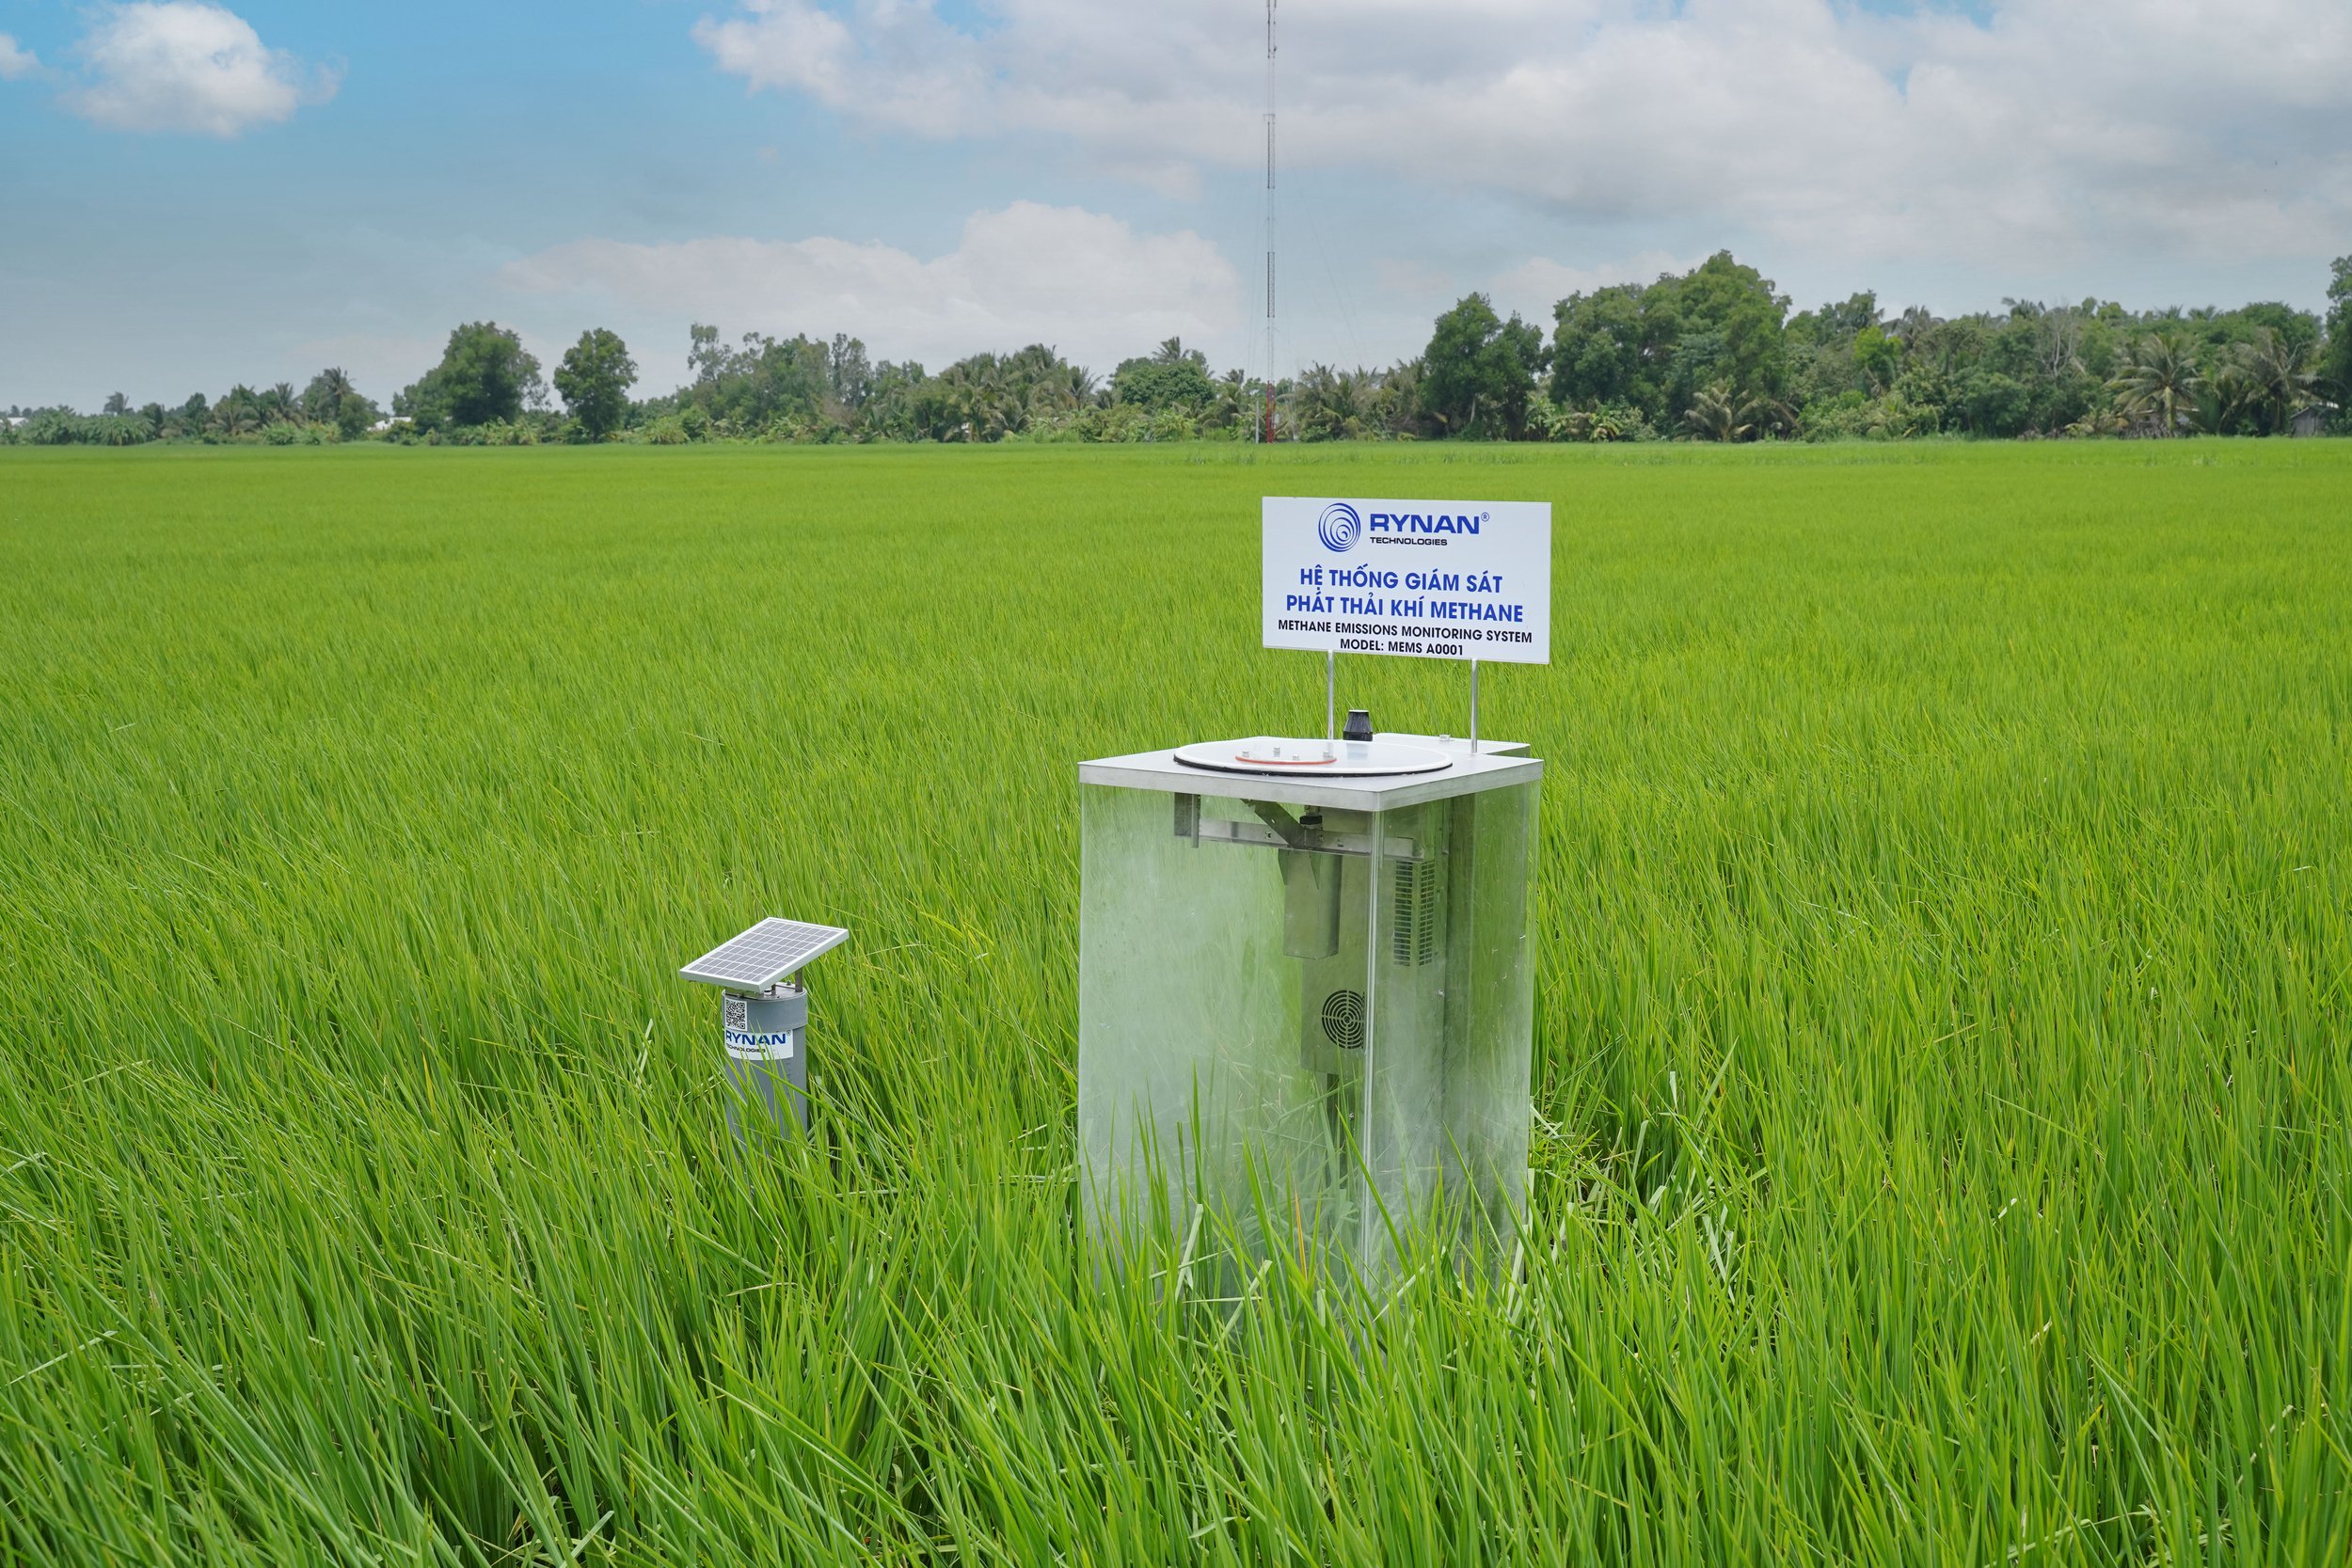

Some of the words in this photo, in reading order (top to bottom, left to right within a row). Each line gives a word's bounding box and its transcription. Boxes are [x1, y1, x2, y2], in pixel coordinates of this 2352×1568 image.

[1370, 536, 1447, 546] TECHNOLOGIES
[1300, 564, 1323, 591] HỆ
[1328, 563, 1399, 589] THỐNG
[1405, 568, 1459, 591] GIÁM
[1466, 570, 1502, 594] SÁT
[1286, 591, 1334, 613] PHÁT
[1340, 592, 1383, 616] THẢI
[1391, 595, 1424, 617] KHÍ
[1430, 601, 1523, 623] METHANE
[1278, 619, 1331, 632] METHANE
[1335, 622, 1398, 636] EMISSIONS
[1401, 626, 1483, 641] MONITORING
[1486, 629, 1533, 643] SYSTEM
[1340, 638, 1384, 651] MODEL:
[1388, 641, 1422, 654] MEMS
[1425, 643, 1464, 656] A0001
